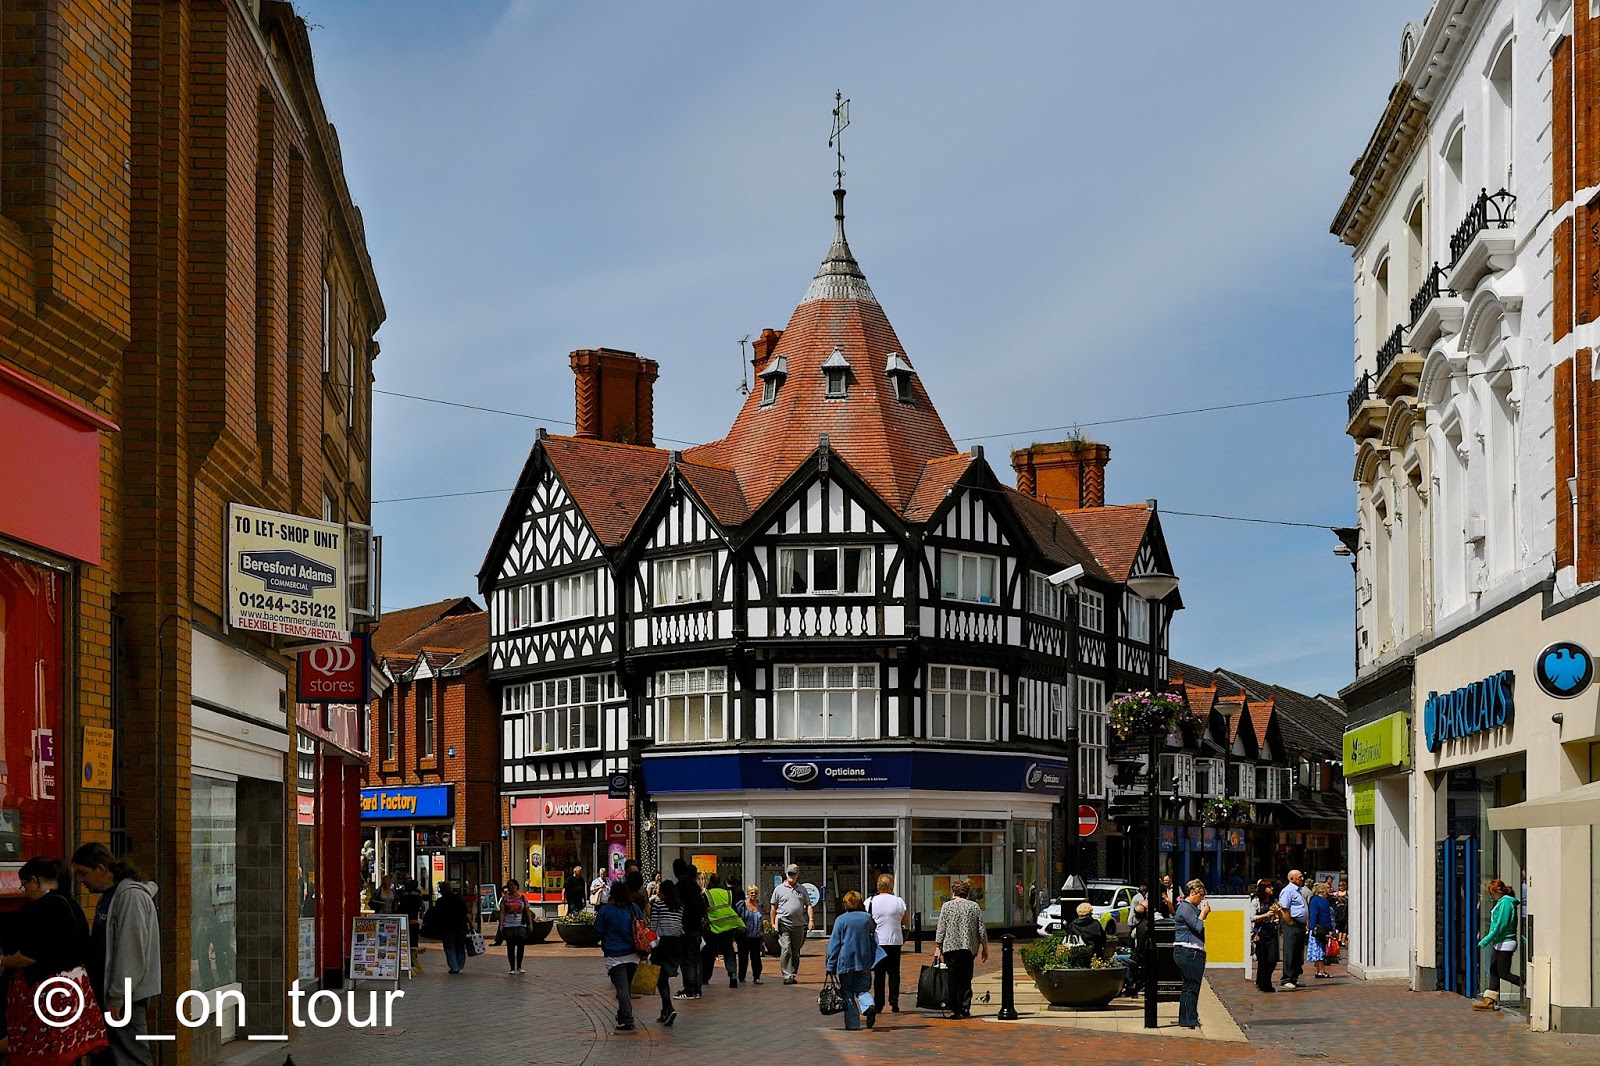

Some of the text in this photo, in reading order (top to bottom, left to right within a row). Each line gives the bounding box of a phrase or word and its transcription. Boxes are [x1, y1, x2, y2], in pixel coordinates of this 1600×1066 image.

[235, 515, 339, 549] TO LET-SHOP UNIT
[242, 555, 333, 584] Beresford Adams
[269, 577, 309, 591] COMMERCIAL
[239, 591, 336, 620] 01244-351212
[238, 617, 343, 641] FLEXIBLE TERMS/RENTAL
[240, 609, 336, 629] www.bacommercial.com
[309, 646, 356, 676] QD
[309, 678, 355, 692] stores
[1438, 669, 1512, 742] BARCLAYS
[824, 767, 866, 777] Opticians
[1042, 773, 1060, 784] Opticians
[380, 792, 417, 814] Factory
[554, 801, 590, 814] vodafone
